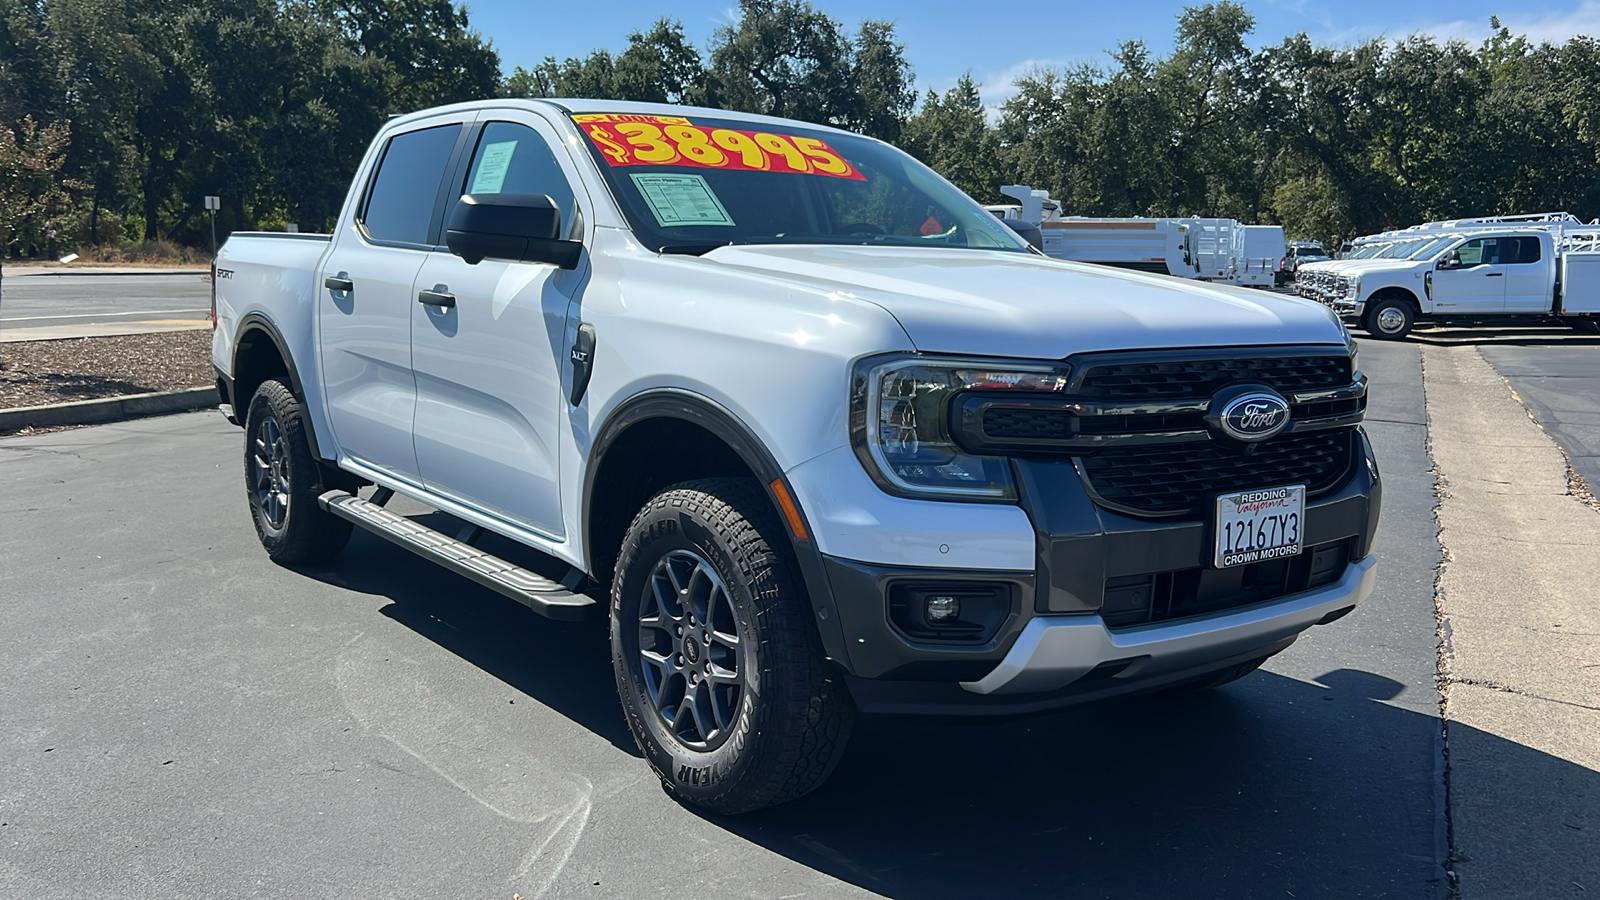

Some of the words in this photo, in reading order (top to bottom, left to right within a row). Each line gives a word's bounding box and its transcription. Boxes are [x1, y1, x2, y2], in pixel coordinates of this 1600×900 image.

[589, 122, 852, 175] $38995
[217, 268, 235, 280] SPORT
[571, 350, 587, 361] XLT
[1240, 403, 1277, 429] Ford
[1241, 489, 1286, 503] REDDING
[1236, 499, 1289, 516] California
[1223, 512, 1298, 555] 12167Y3
[1224, 550, 1258, 566] CROWN
[1260, 544, 1298, 560] MOTORS
